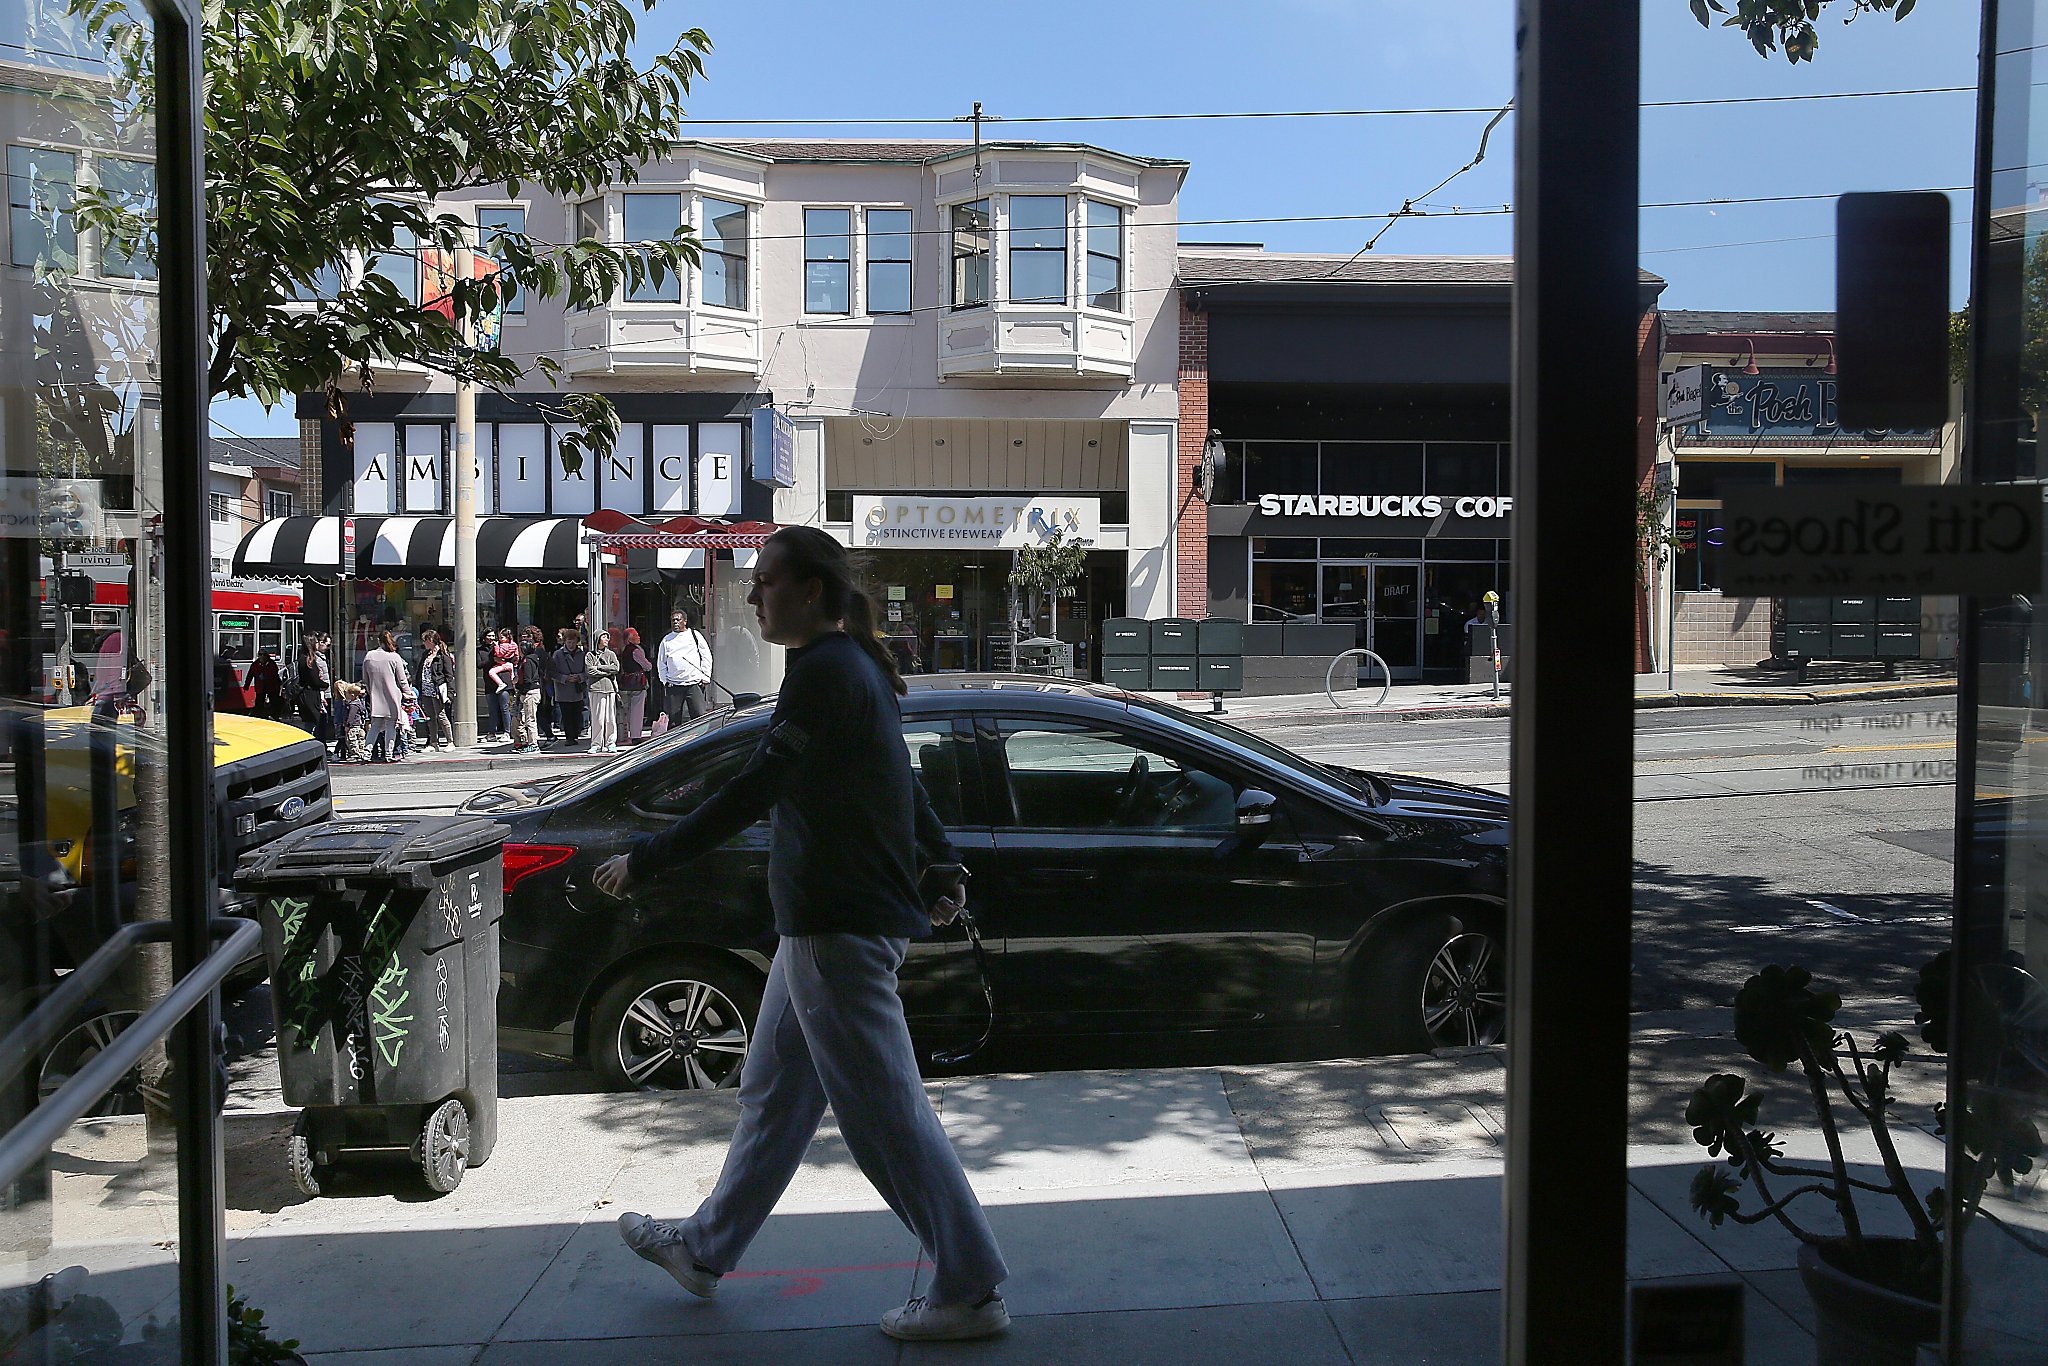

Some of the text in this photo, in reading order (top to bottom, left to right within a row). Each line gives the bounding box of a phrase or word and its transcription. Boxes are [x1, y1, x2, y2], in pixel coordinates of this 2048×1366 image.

[1726, 404, 1743, 415] the
[1745, 380, 1813, 429] Posh
[1259, 493, 1513, 518] STARBUCKS COF
[868, 505, 1081, 529] OPTOMETRIX
[948, 529, 1003, 539] EYEWEAR
[80, 556, 111, 565] Irving
[226, 578, 244, 588] Electric
[1384, 585, 1411, 597] DRAFT
